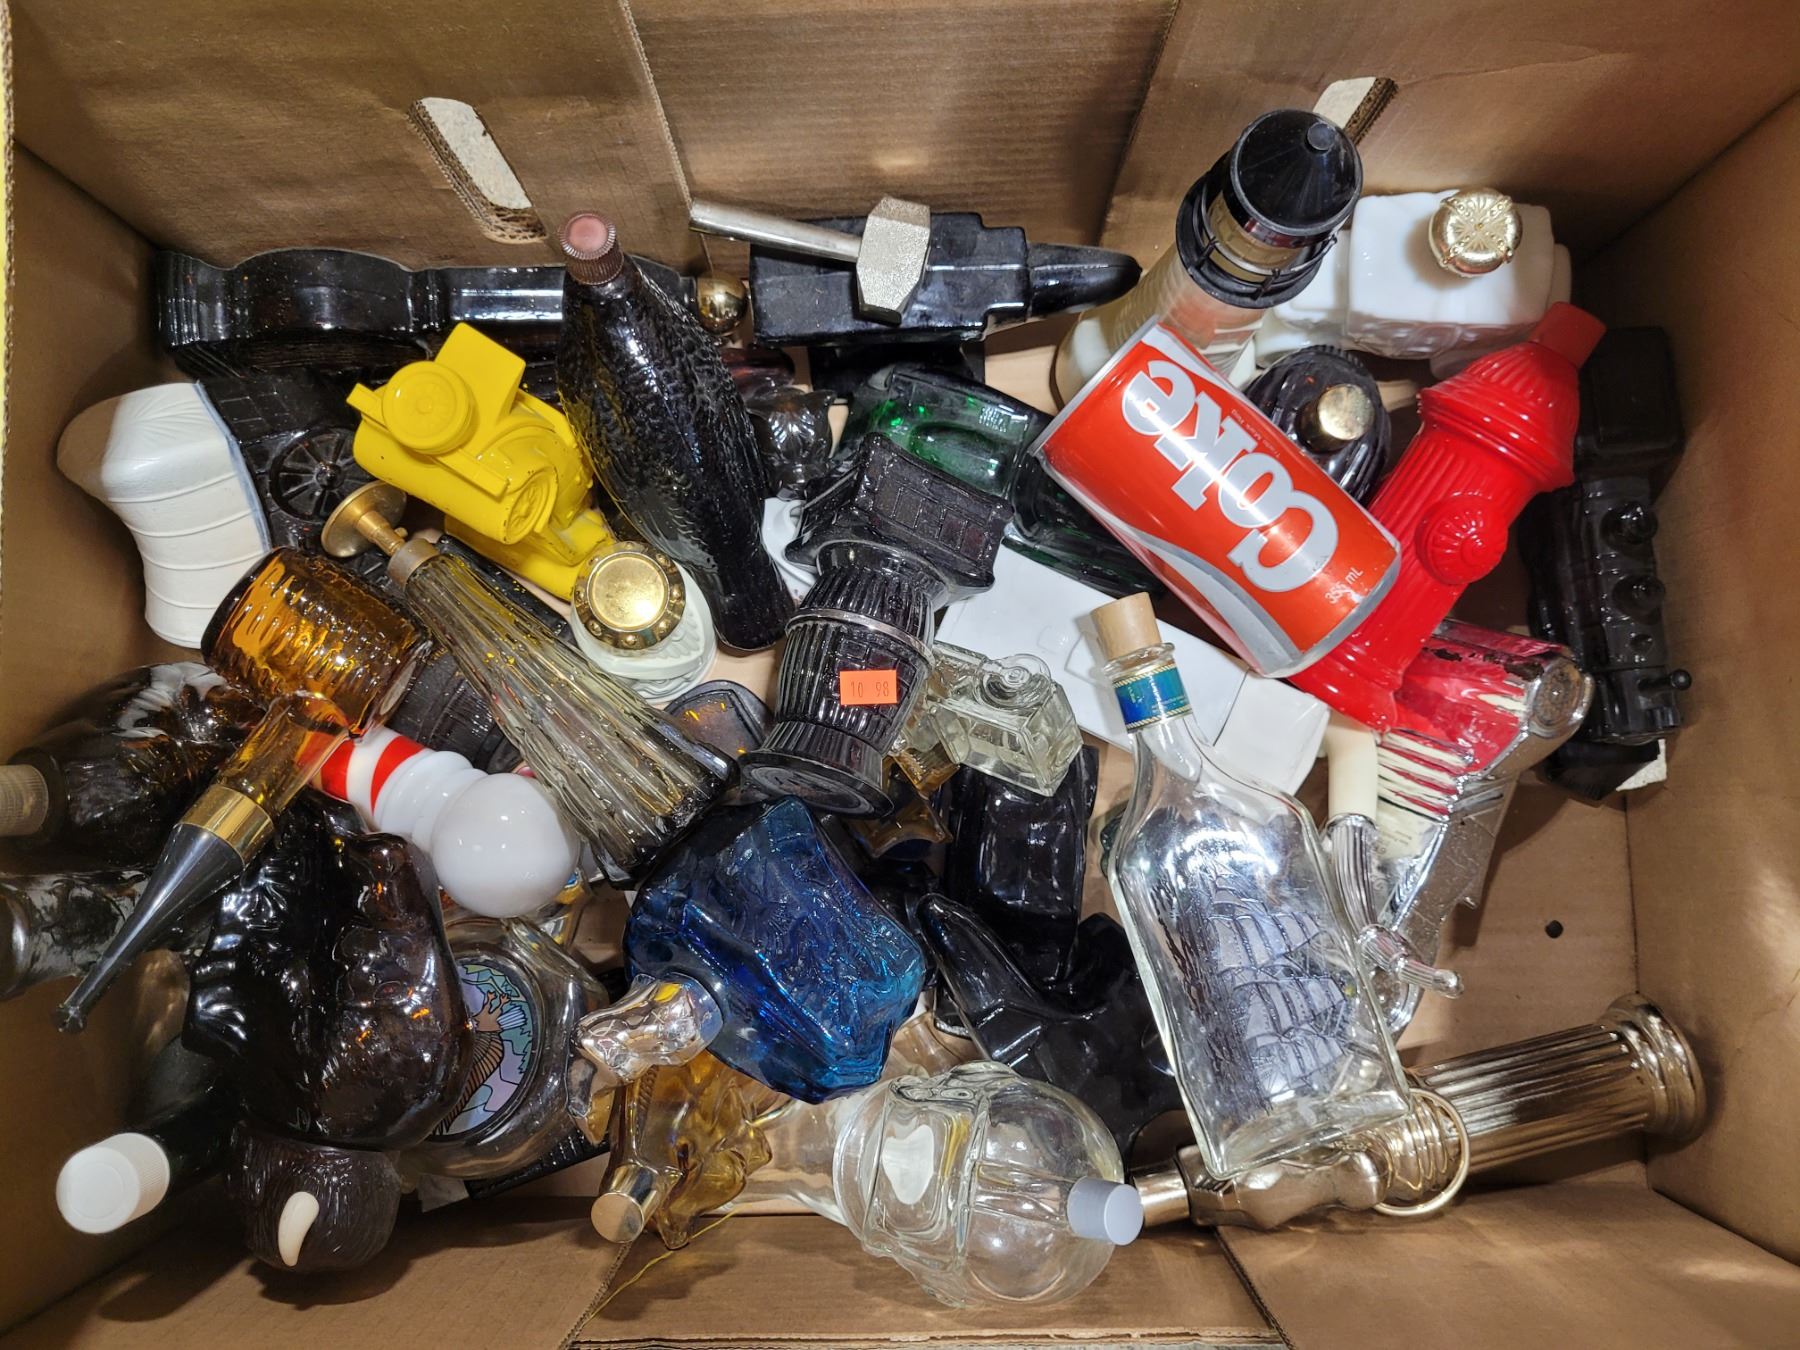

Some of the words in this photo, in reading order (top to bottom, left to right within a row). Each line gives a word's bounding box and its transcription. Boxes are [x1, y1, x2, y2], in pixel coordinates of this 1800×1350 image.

[1122, 359, 1339, 592] Coke
[1324, 581, 1348, 604] 355
[1345, 567, 1364, 585] mL
[850, 681, 864, 698] 10
[875, 681, 889, 697] 98
